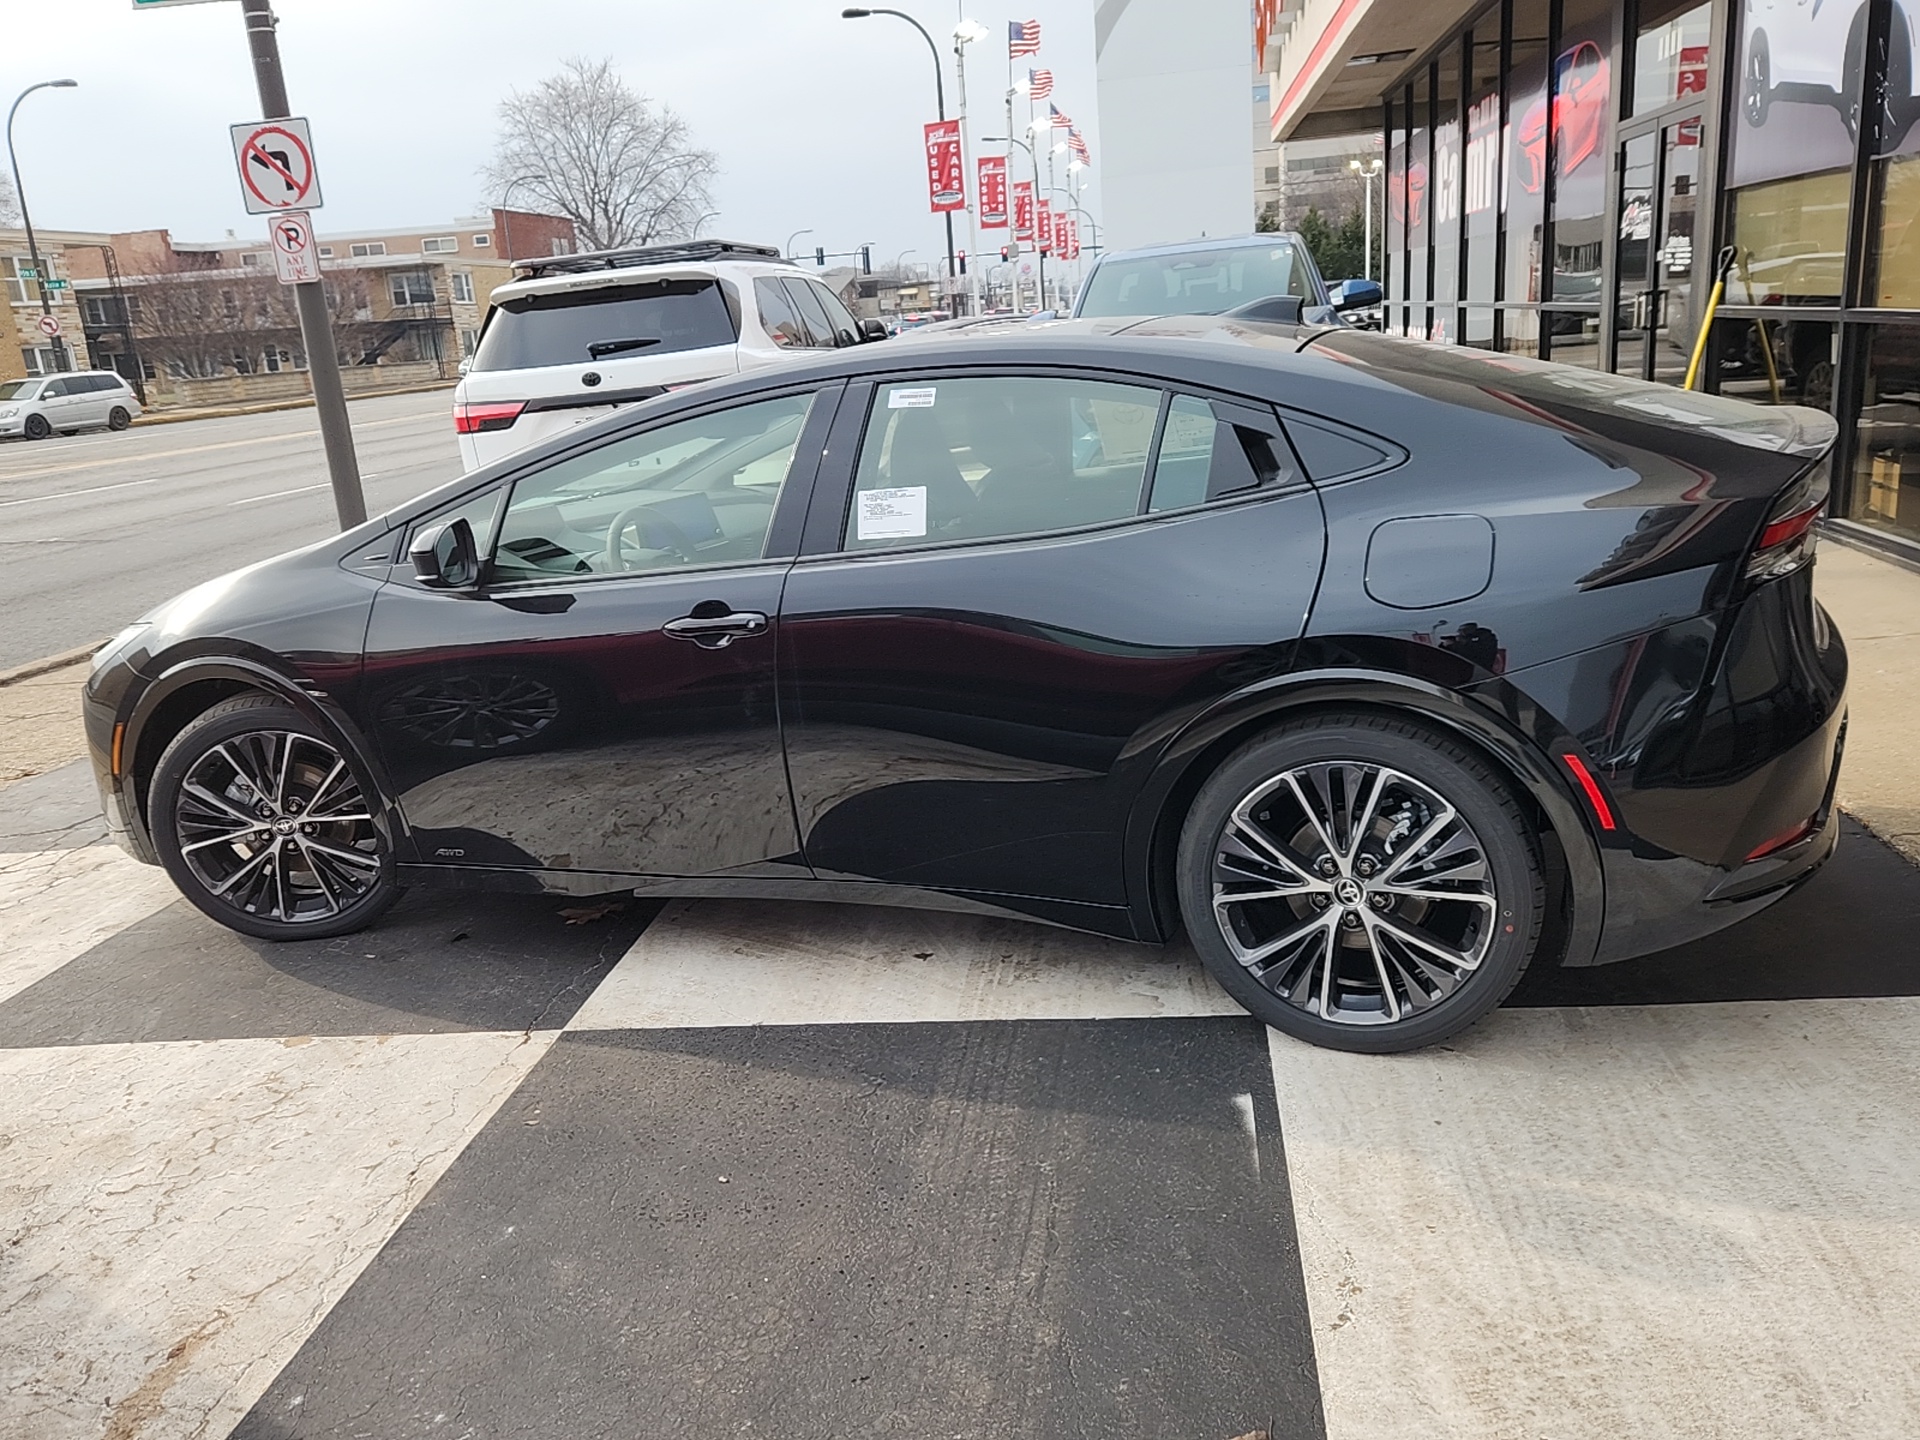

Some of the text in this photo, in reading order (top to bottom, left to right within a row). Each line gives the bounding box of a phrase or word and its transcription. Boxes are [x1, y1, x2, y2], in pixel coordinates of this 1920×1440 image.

[929, 145, 941, 191] USED
[949, 143, 960, 189] CARS
[981, 175, 990, 213] USED
[996, 174, 1004, 212] CARS
[286, 254, 304, 266] ANY
[435, 848, 464, 857] AWD
